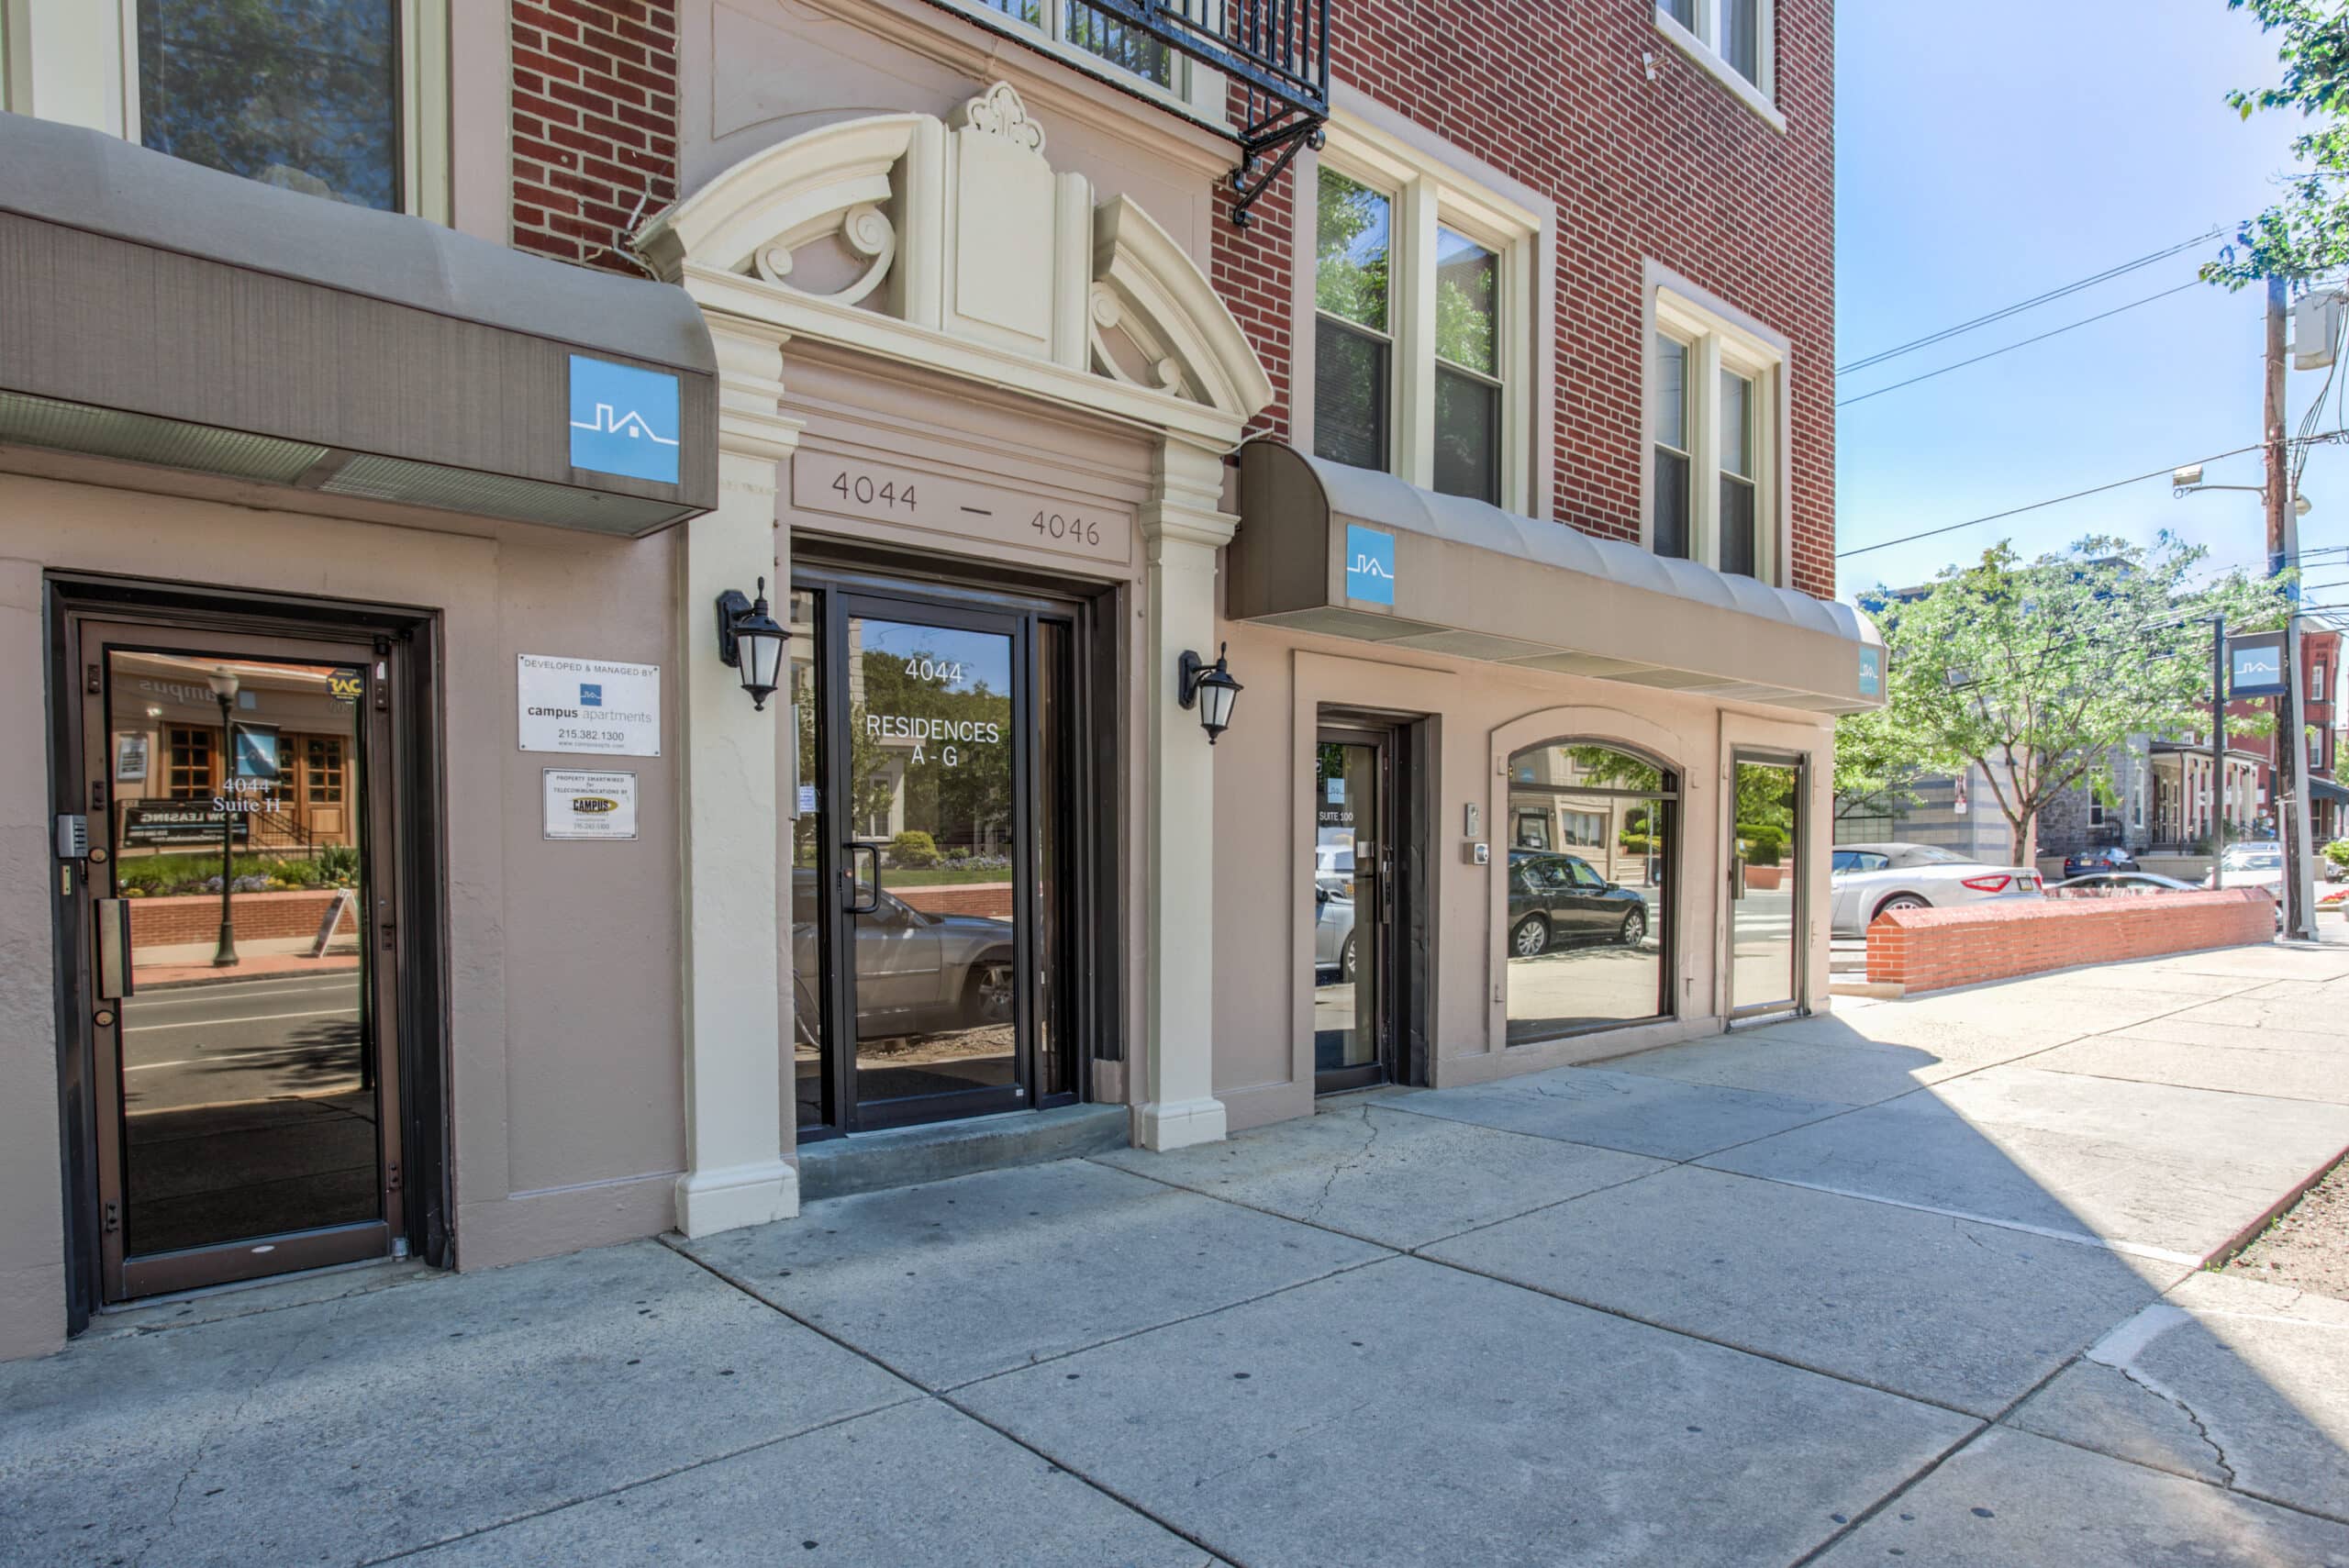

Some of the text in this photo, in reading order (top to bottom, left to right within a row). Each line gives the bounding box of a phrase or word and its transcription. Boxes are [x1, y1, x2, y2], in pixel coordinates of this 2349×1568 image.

[831, 472, 917, 512] 4044
[1031, 510, 1100, 546] 4046
[524, 660, 653, 677] DEVELOPED & MANAGED BY
[905, 659, 963, 684] 4044
[528, 706, 652, 724] campus apartments
[558, 728, 625, 741] 215.382.1300
[866, 714, 999, 743] RESIDENCES
[911, 744, 925, 765] A
[942, 746, 958, 767] G
[223, 777, 272, 794] 4044
[213, 796, 282, 813] Suite H
[573, 799, 609, 812] CAMPUS
[1319, 811, 1353, 822] SUITE 100
